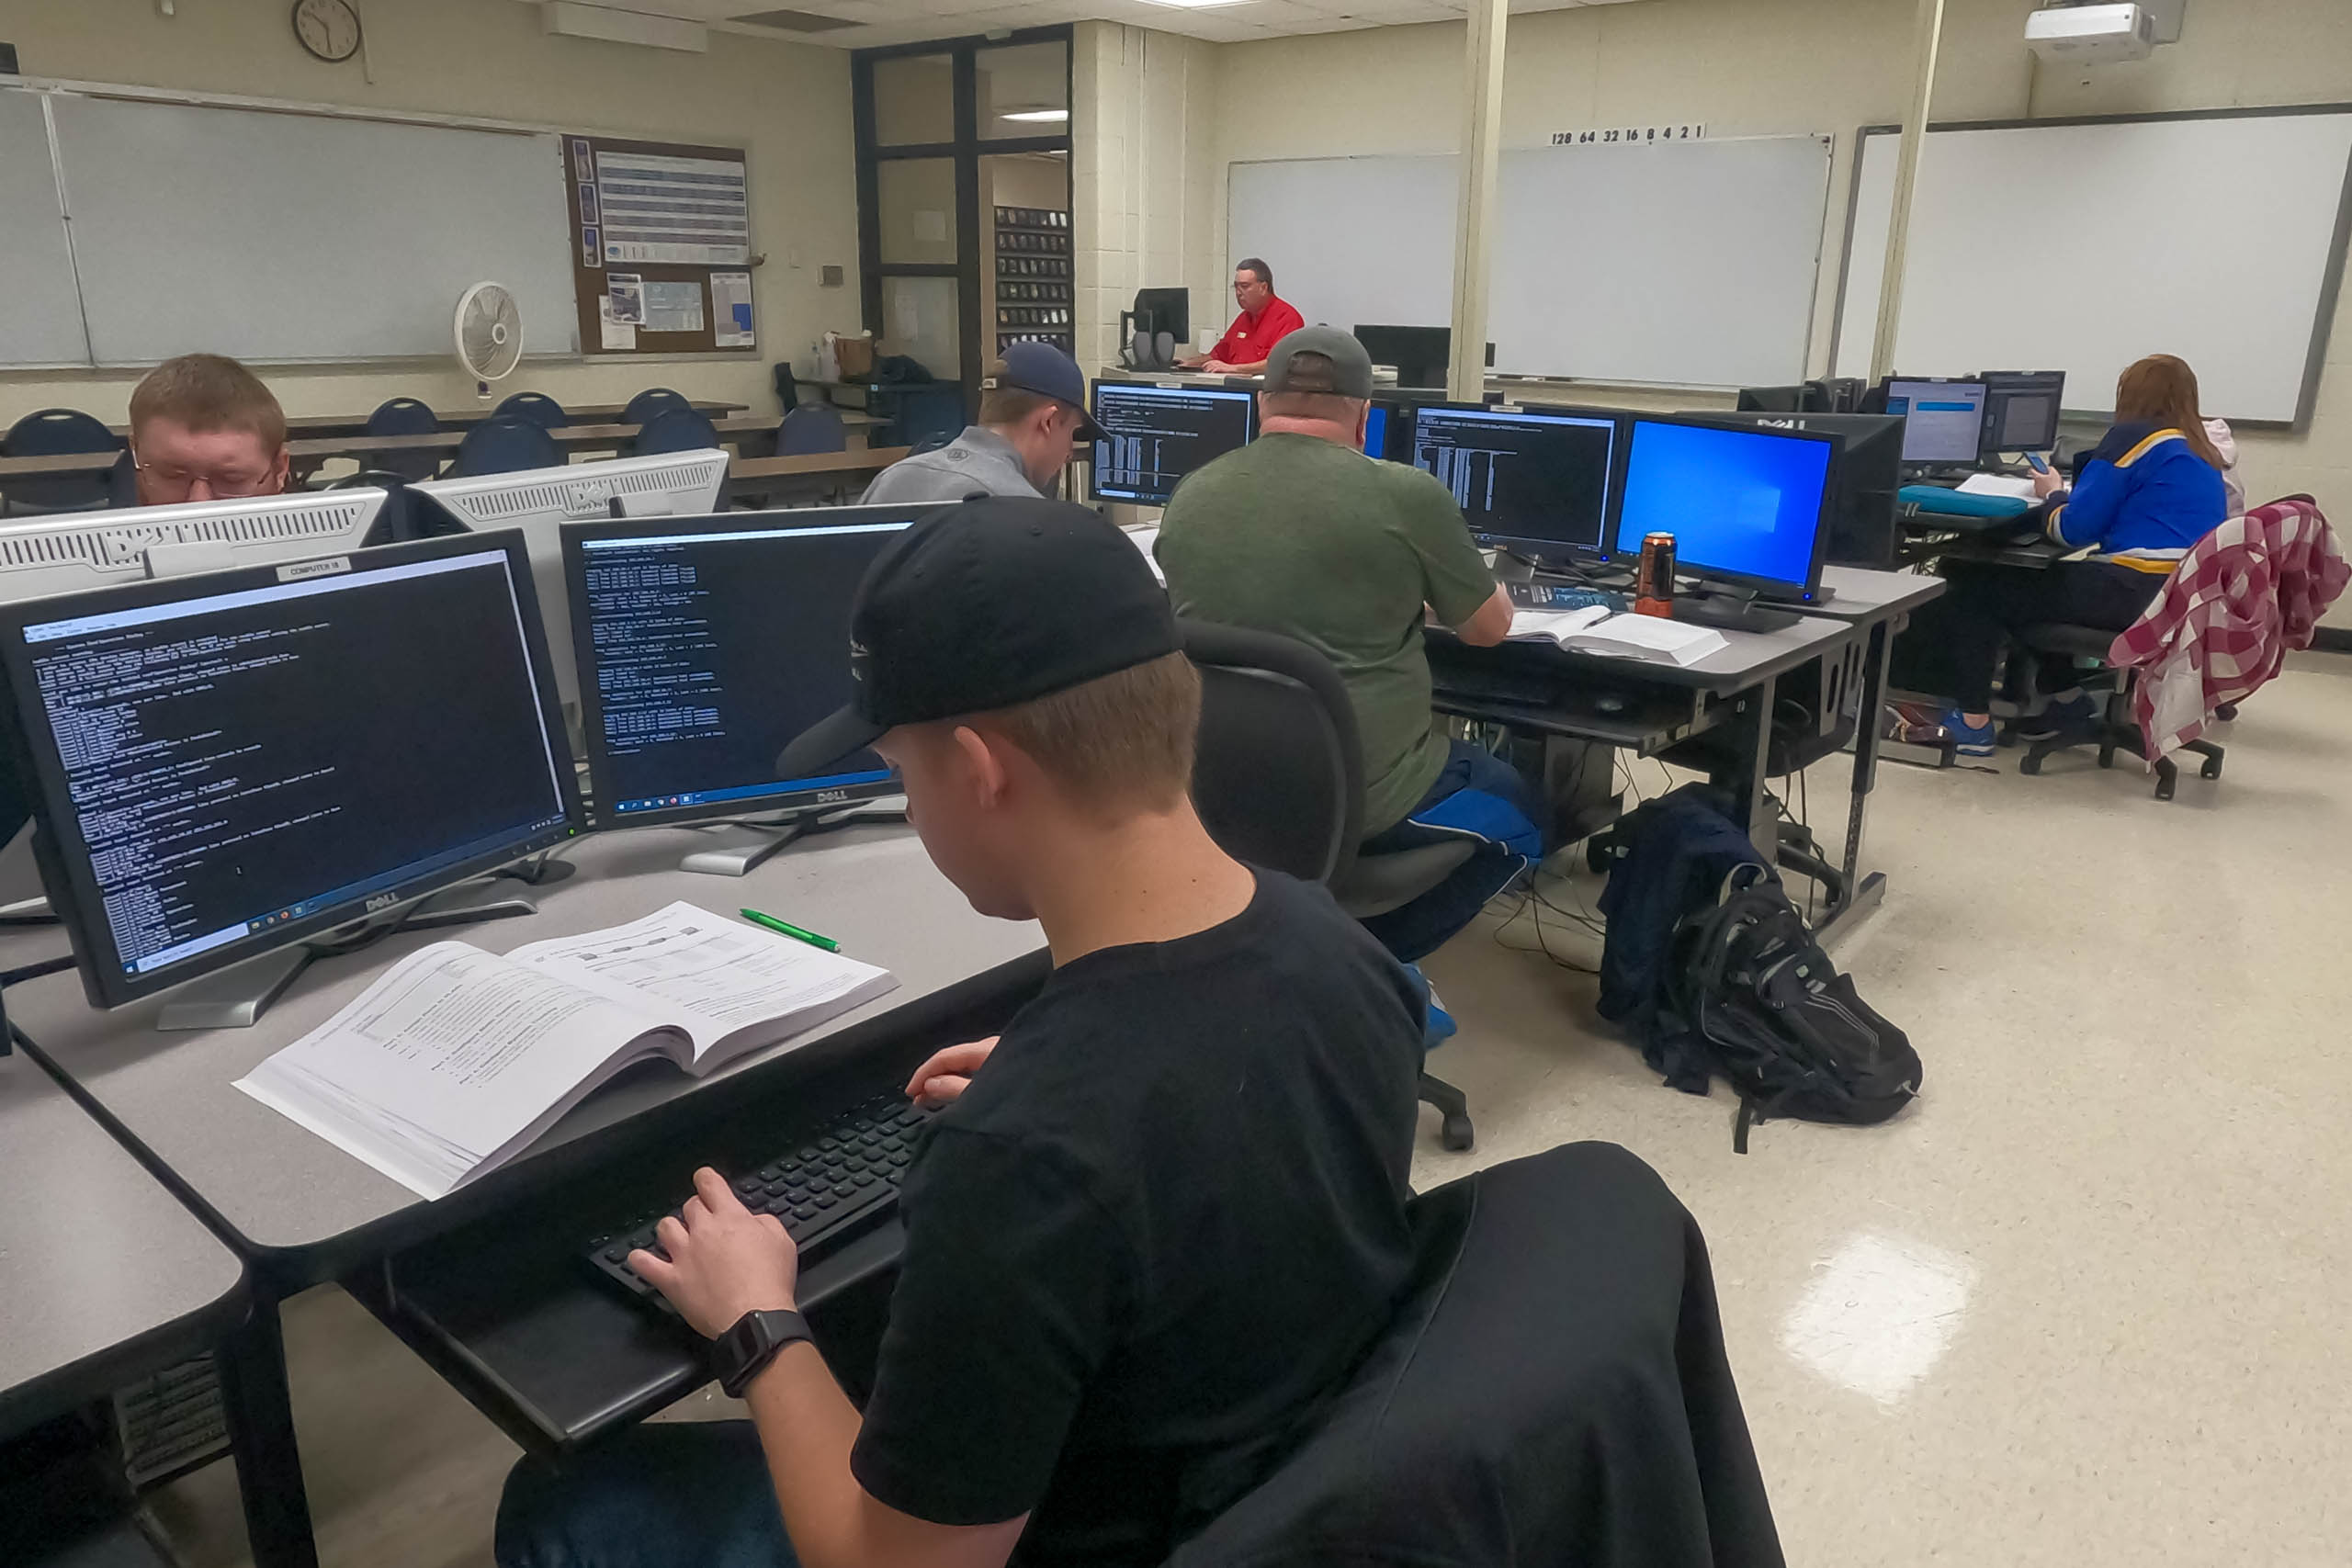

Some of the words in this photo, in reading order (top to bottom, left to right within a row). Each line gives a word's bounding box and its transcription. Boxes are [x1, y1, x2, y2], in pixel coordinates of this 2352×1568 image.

[1552, 133, 1572, 144] 128
[1579, 131, 1596, 143] 64
[1603, 130, 1619, 142] 32
[1625, 129, 1638, 141] 16
[1646, 128, 1655, 140] 8
[1663, 127, 1671, 139] 4
[1679, 126, 1689, 138] 2
[1696, 125, 1702, 137] 1
[817, 790, 848, 803] DELL
[366, 892, 400, 912] DELL
